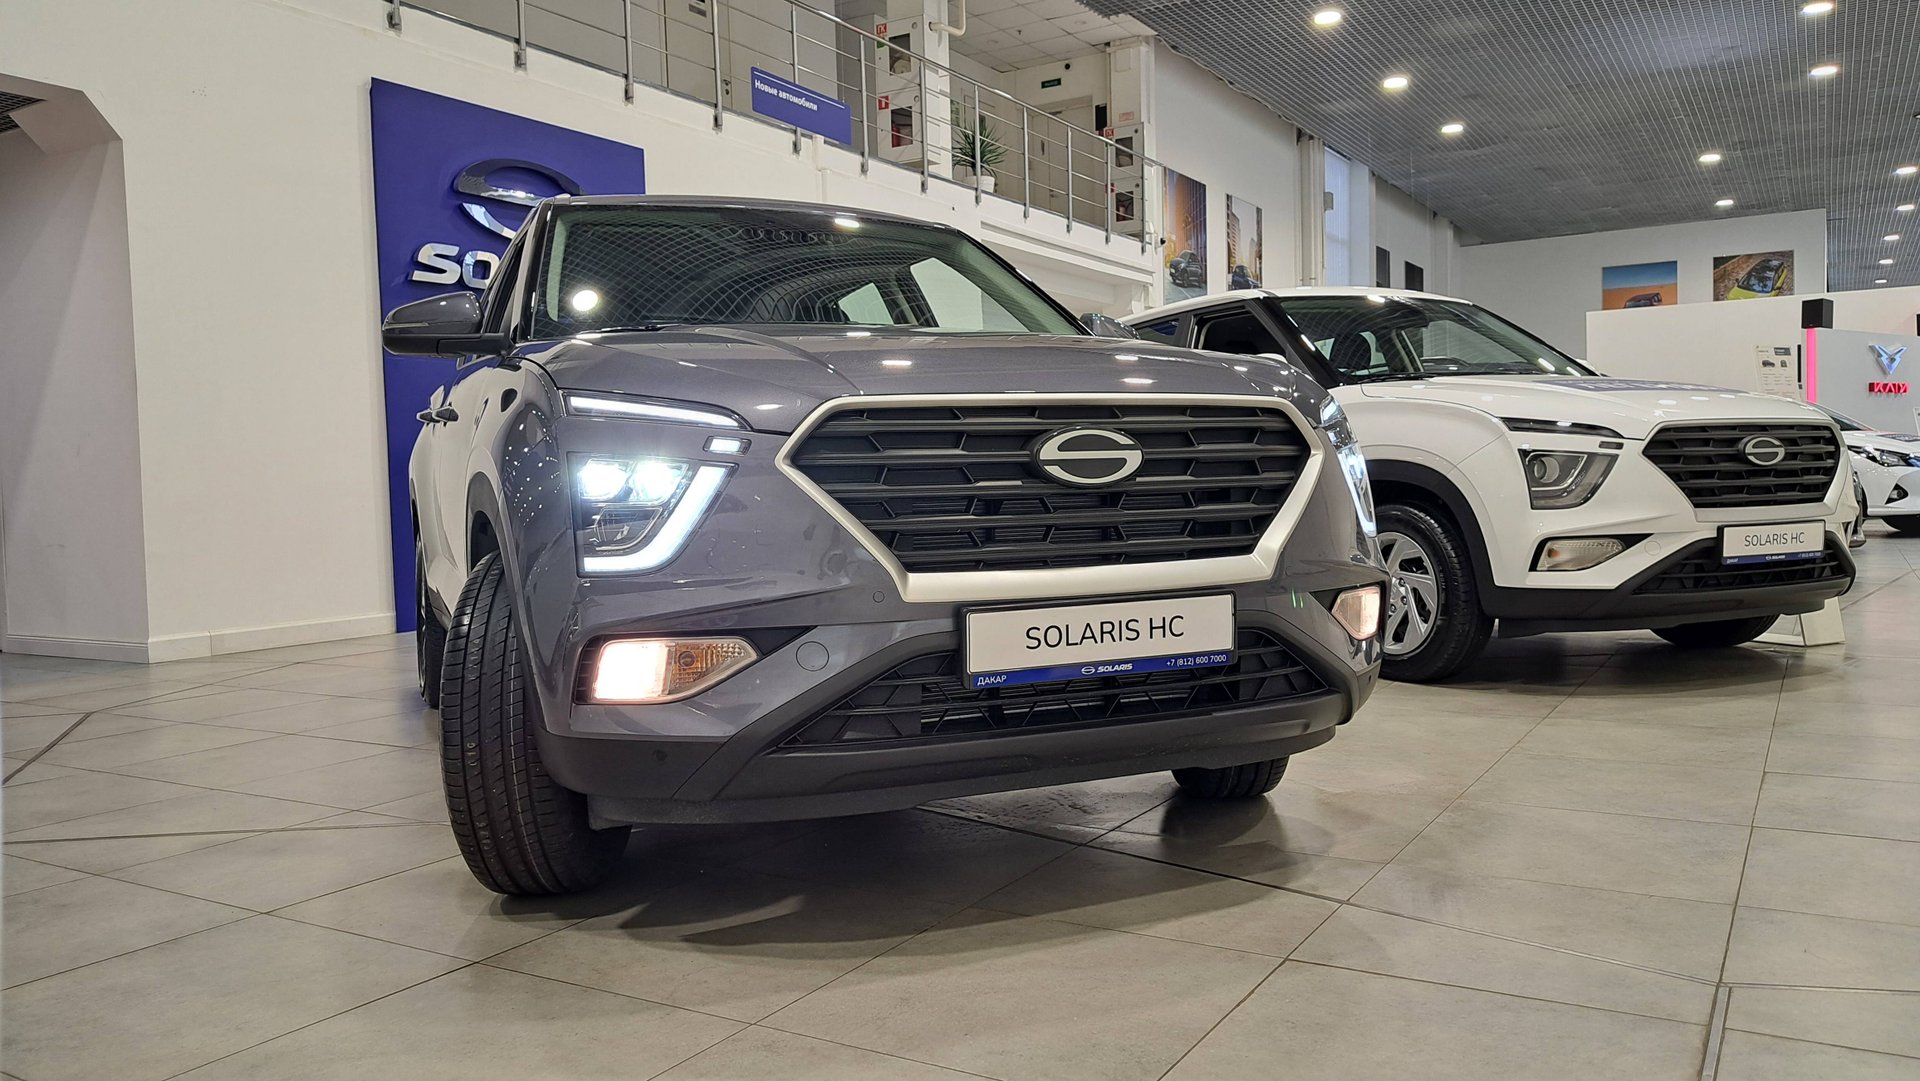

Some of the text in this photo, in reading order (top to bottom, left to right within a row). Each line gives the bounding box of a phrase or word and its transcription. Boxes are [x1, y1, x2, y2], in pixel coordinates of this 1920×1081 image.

[754, 79, 818, 112] Новые автомобили
[1743, 531, 1805, 548] SOLARIS HC
[1025, 615, 1185, 650] SOLARIS HC
[1096, 663, 1133, 673] SOLARIS
[1166, 654, 1227, 667] +7 (812) 600 7000
[977, 674, 1007, 686] ДАКАР
